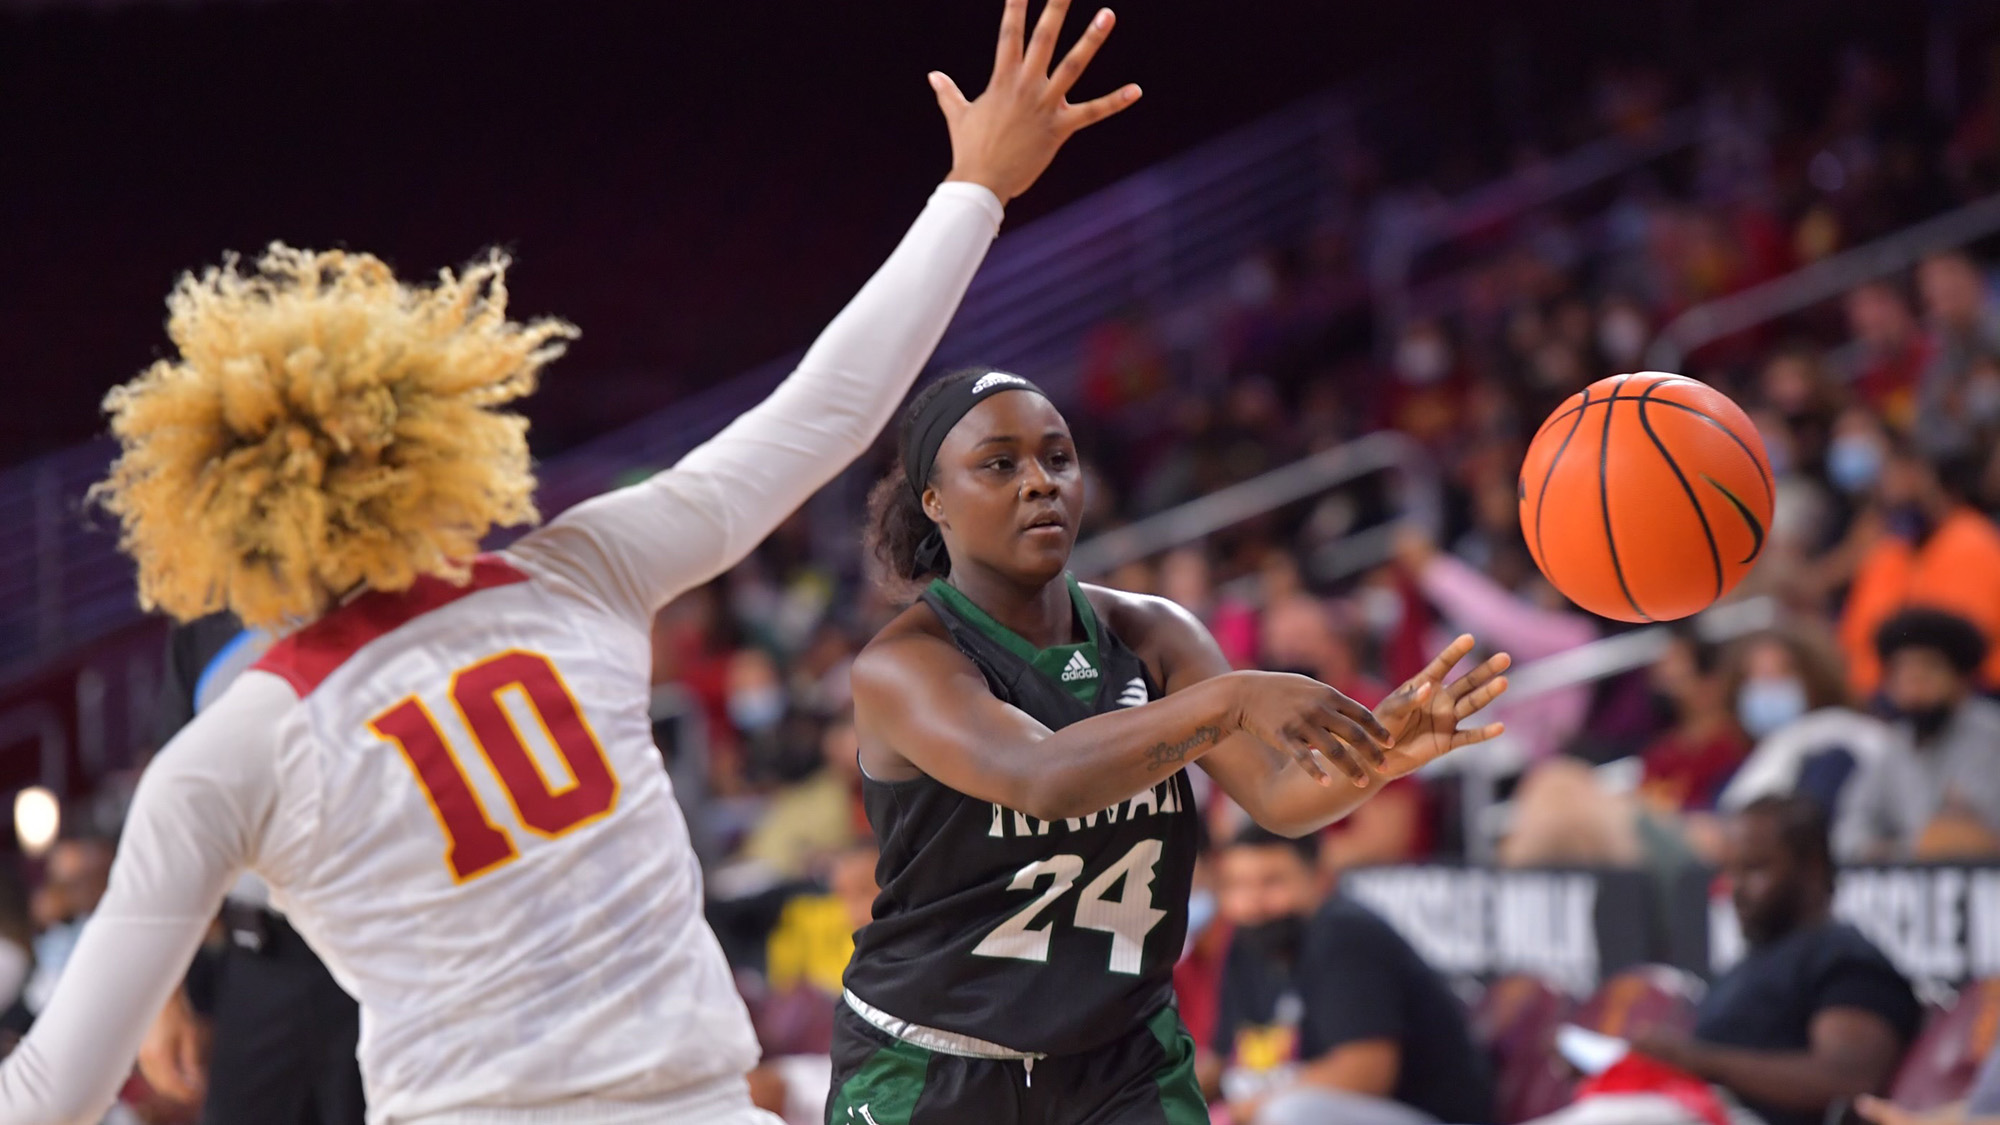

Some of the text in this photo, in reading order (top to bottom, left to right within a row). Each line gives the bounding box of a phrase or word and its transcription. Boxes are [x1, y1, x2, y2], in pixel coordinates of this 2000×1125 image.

[1061, 667, 1098, 682] adidas
[365, 648, 621, 885] 10
[1144, 726, 1221, 772] Loyalty
[971, 839, 1167, 975] 24
